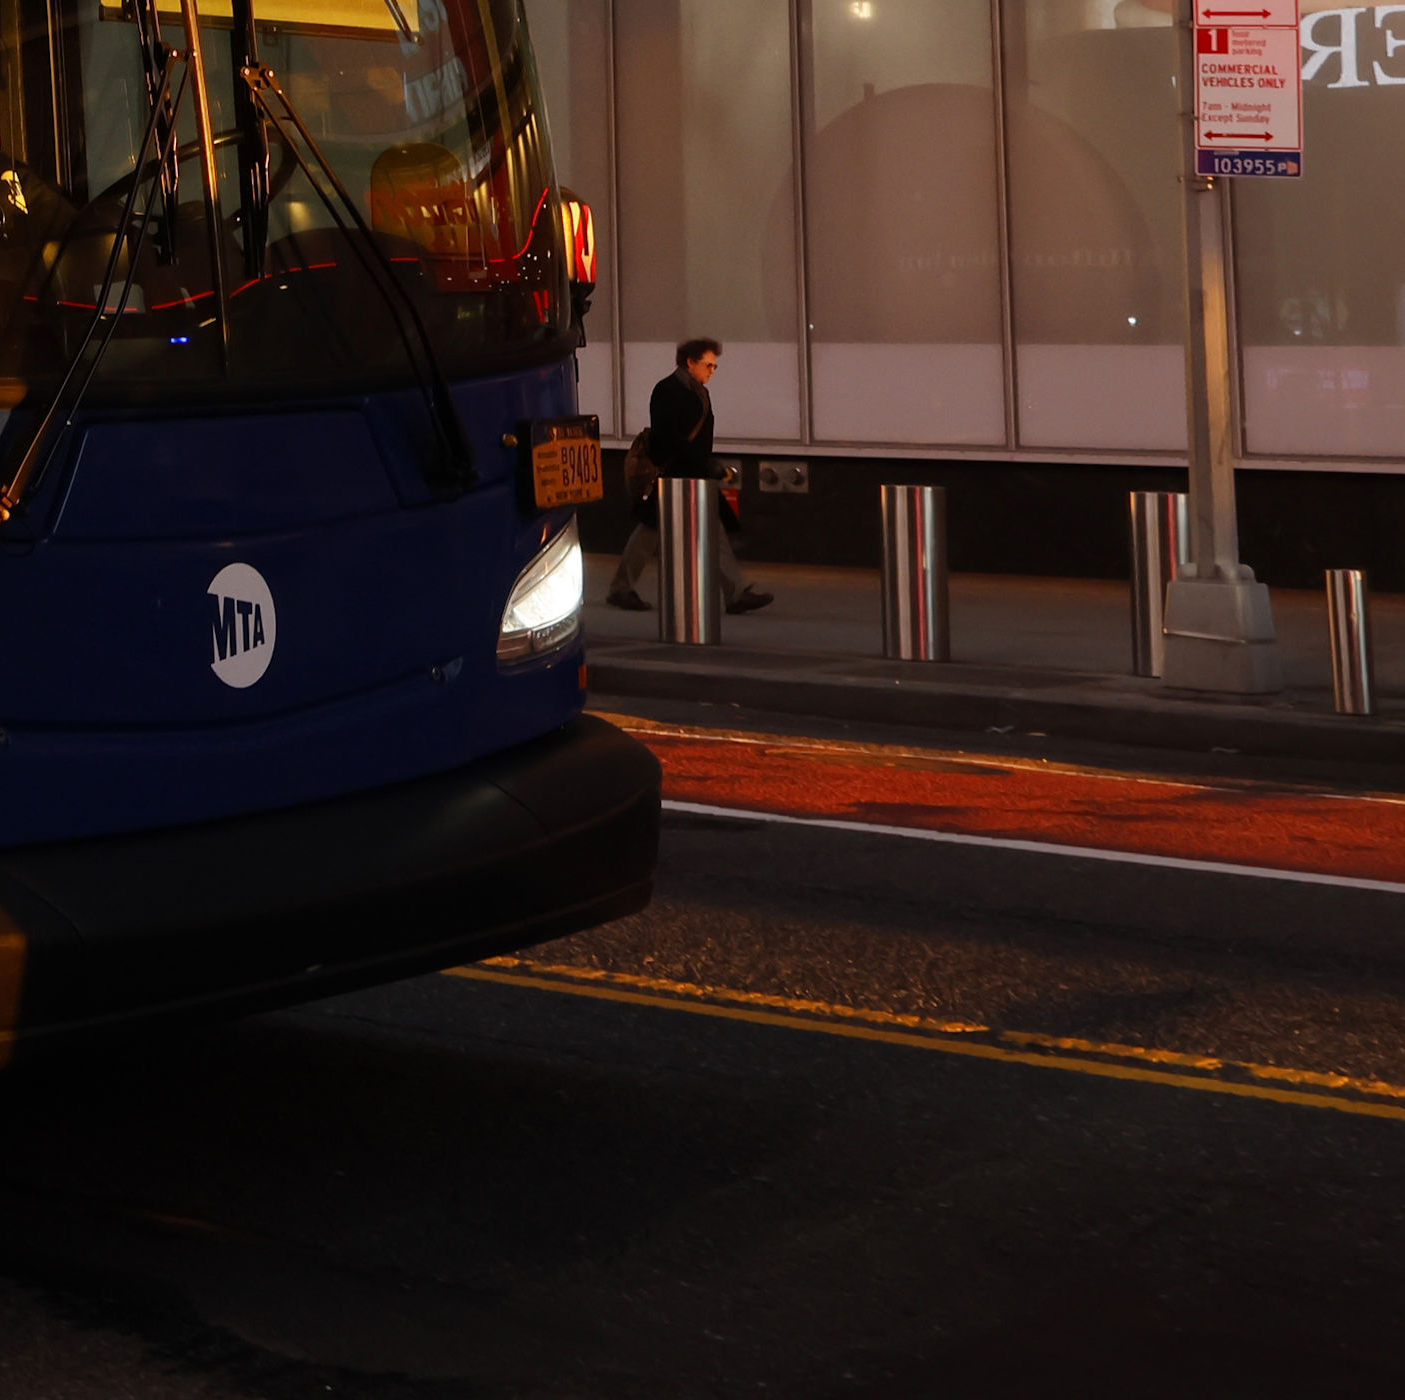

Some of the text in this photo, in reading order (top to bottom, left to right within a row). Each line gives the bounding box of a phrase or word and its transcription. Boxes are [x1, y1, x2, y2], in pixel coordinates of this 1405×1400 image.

[1207, 29, 1219, 52] 1
[1232, 38, 1266, 48] metered
[1202, 63, 1278, 76] COMMERCIAL
[1202, 77, 1286, 89] VEHICLES ONLY
[1202, 101, 1222, 111] 7am
[1232, 101, 1271, 113] Midnight
[1202, 113, 1270, 125] Except Sunday
[1214, 158, 1276, 175] 103955
[569, 443, 598, 484] 9483
[211, 596, 265, 662] MTA
